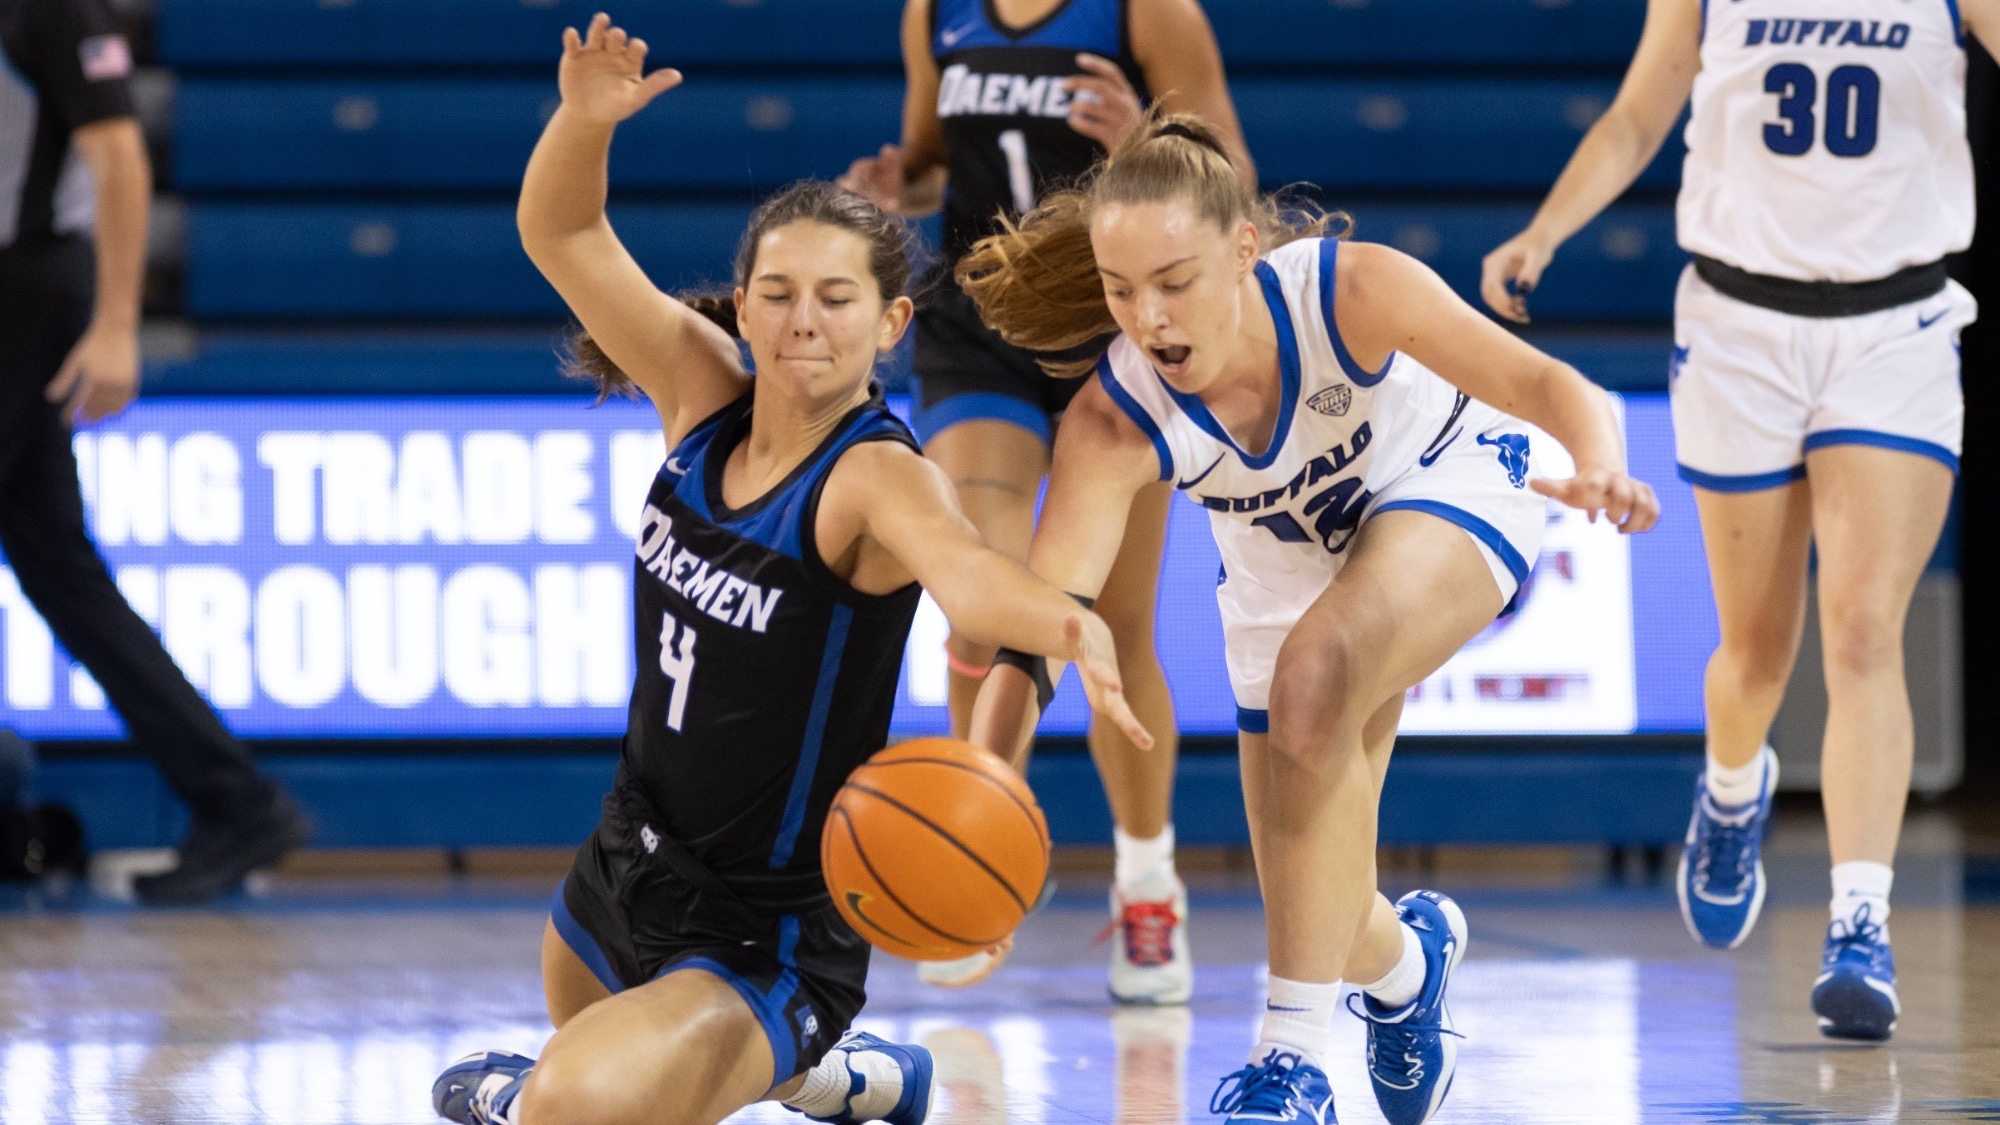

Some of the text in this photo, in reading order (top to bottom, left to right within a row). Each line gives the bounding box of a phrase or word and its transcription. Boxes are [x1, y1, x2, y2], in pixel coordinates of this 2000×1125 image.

[1744, 19, 1911, 49] BUFFALO
[937, 63, 1103, 118] DAEME
[1762, 62, 1880, 157] 30
[998, 129, 1034, 214] 1
[256, 430, 597, 545] TRADE
[1198, 421, 1372, 512] BUFFALO
[636, 503, 784, 633] DAEMEN
[659, 609, 697, 733] 4
